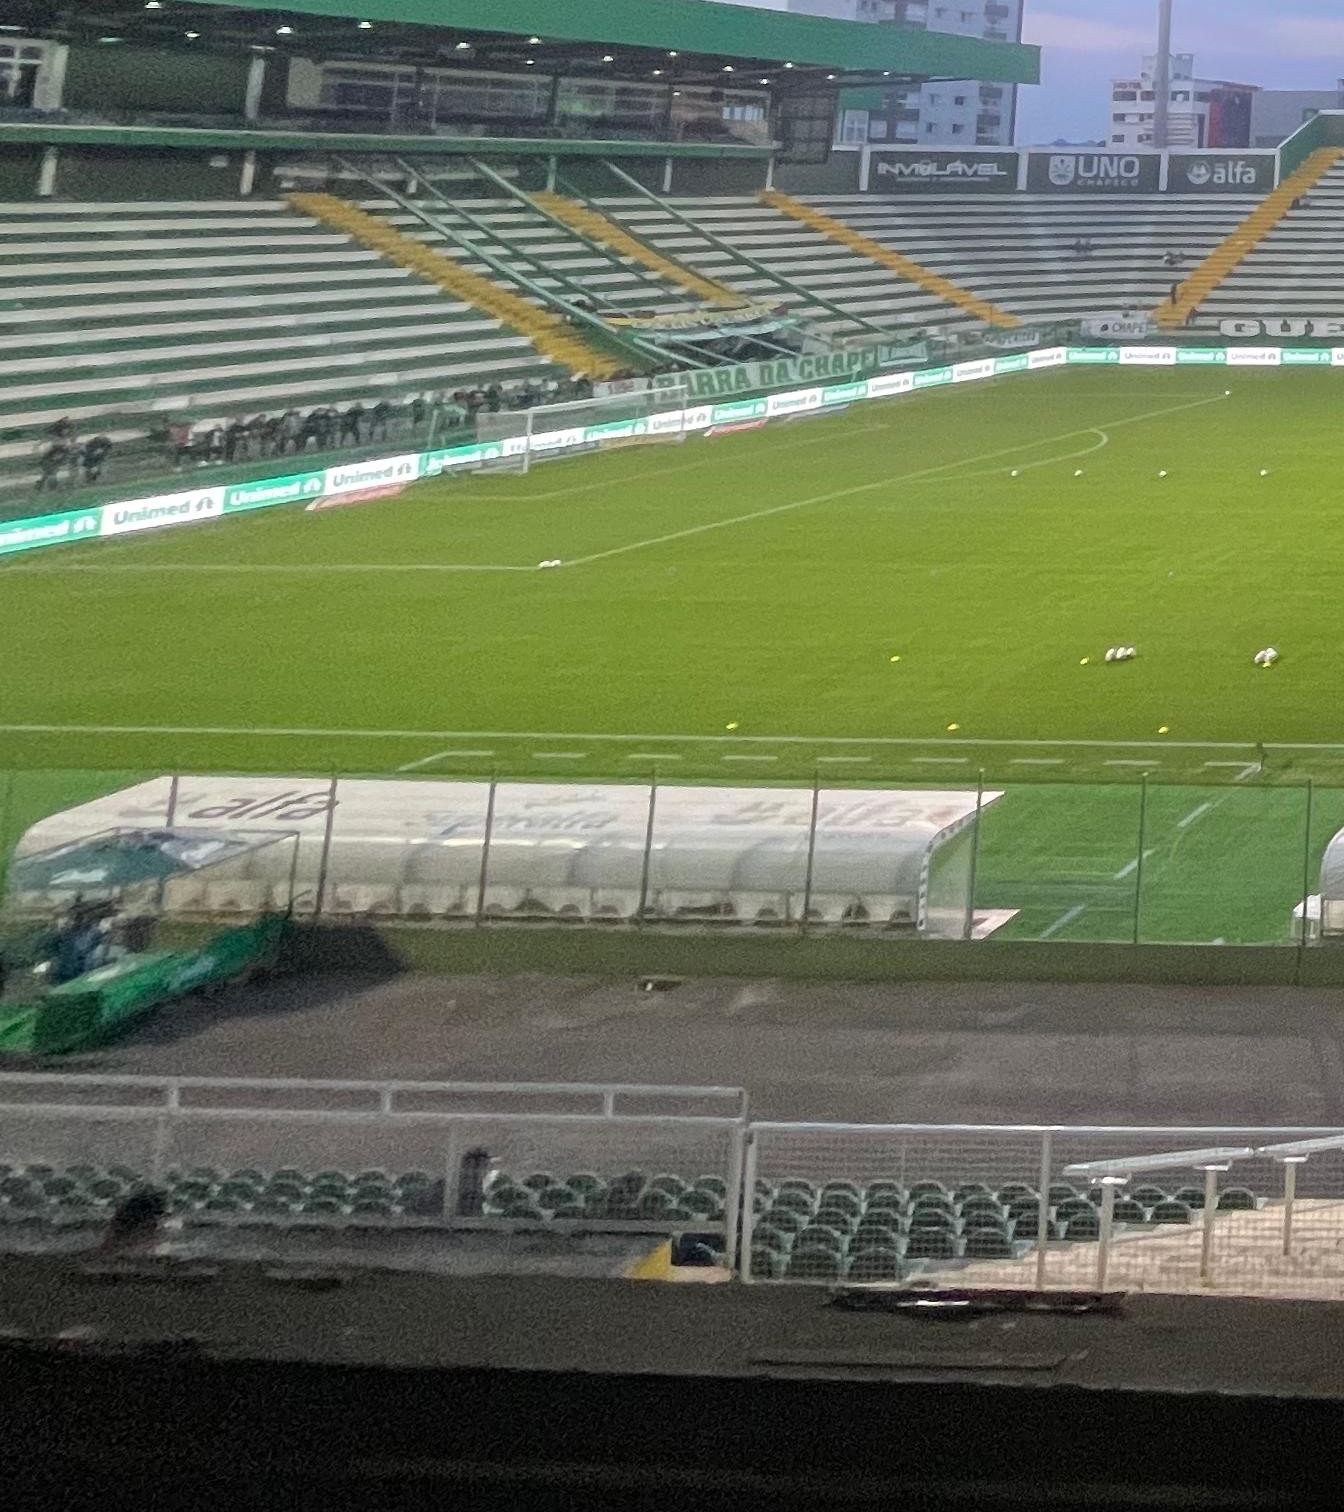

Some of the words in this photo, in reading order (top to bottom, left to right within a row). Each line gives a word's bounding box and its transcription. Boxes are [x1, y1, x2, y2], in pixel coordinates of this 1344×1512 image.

[1078, 155, 1140, 178] UNO
[333, 466, 393, 487] Unimed
[113, 500, 192, 526] Unimed
[188, 790, 341, 821] alfa
